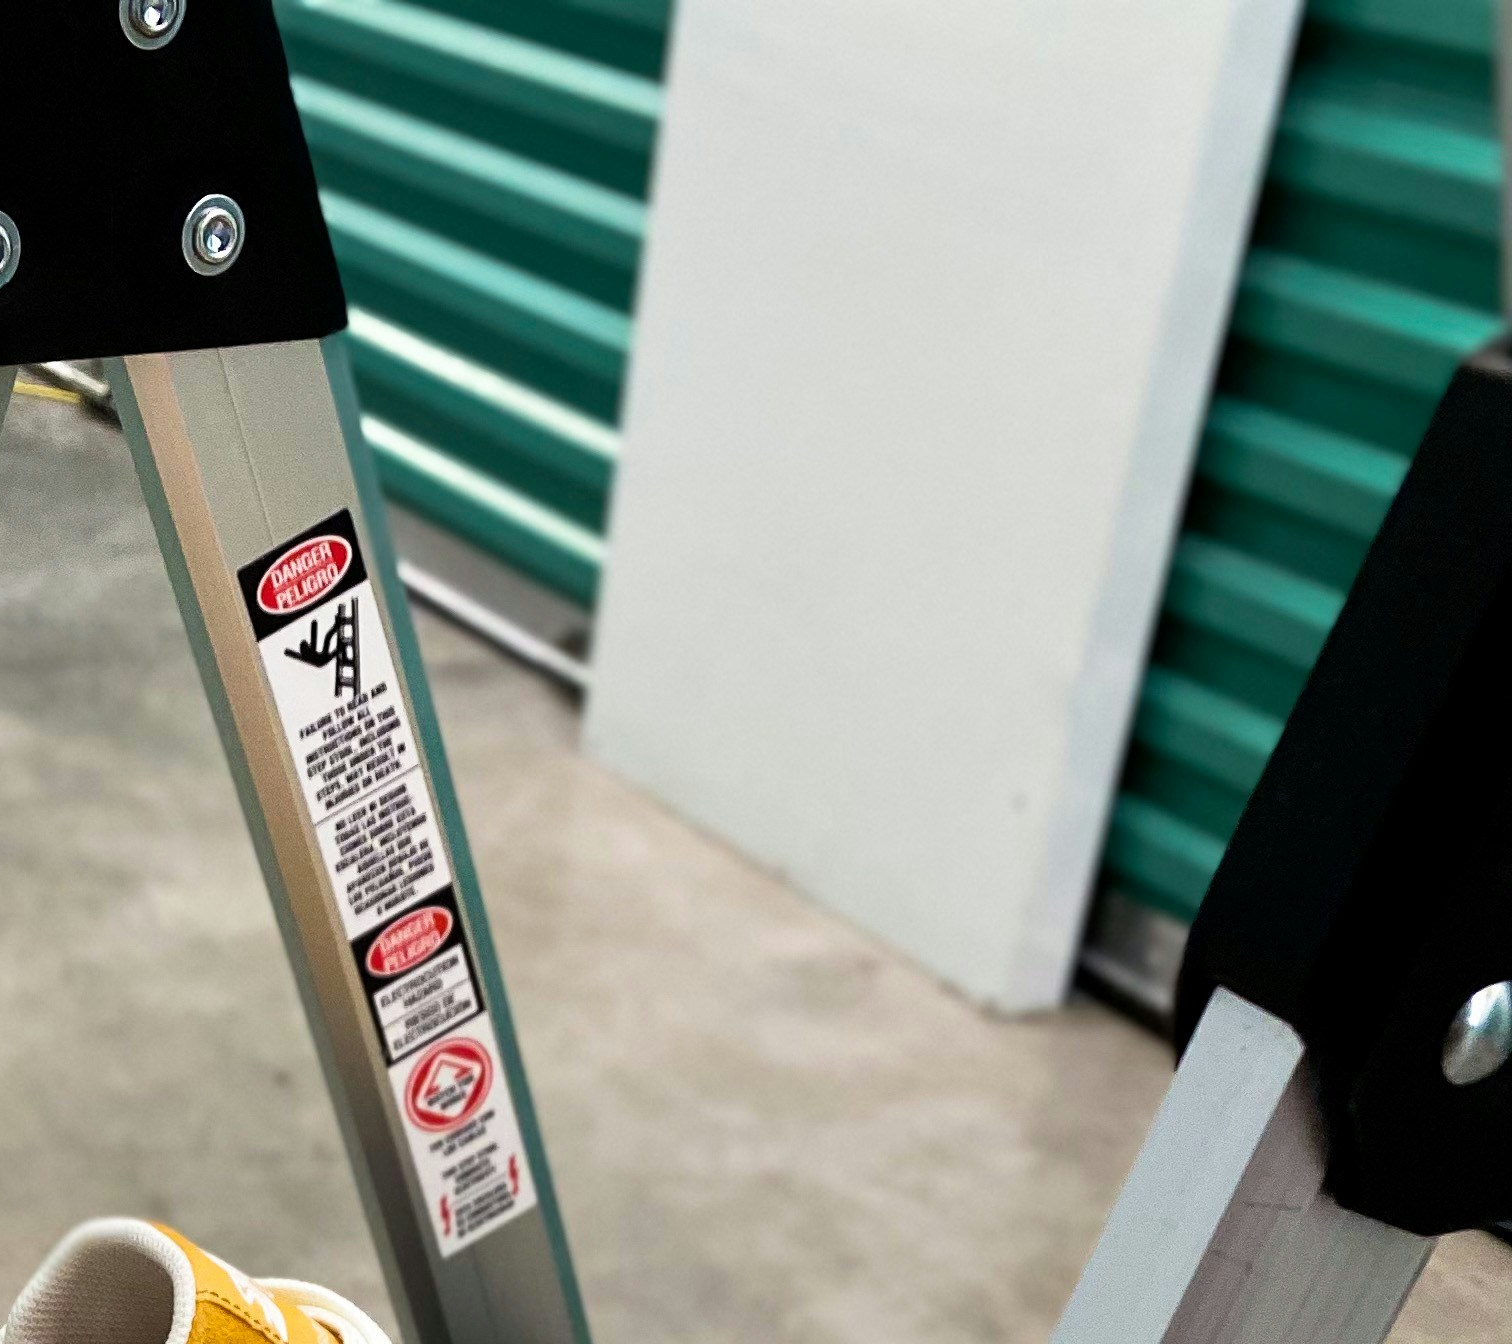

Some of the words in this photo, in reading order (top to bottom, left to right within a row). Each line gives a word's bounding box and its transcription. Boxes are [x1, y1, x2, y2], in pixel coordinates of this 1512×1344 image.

[270, 541, 333, 589] DANGER
[274, 563, 338, 611] PELIGRO
[379, 911, 436, 955] DANGER
[383, 929, 441, 972] PELIGRO
